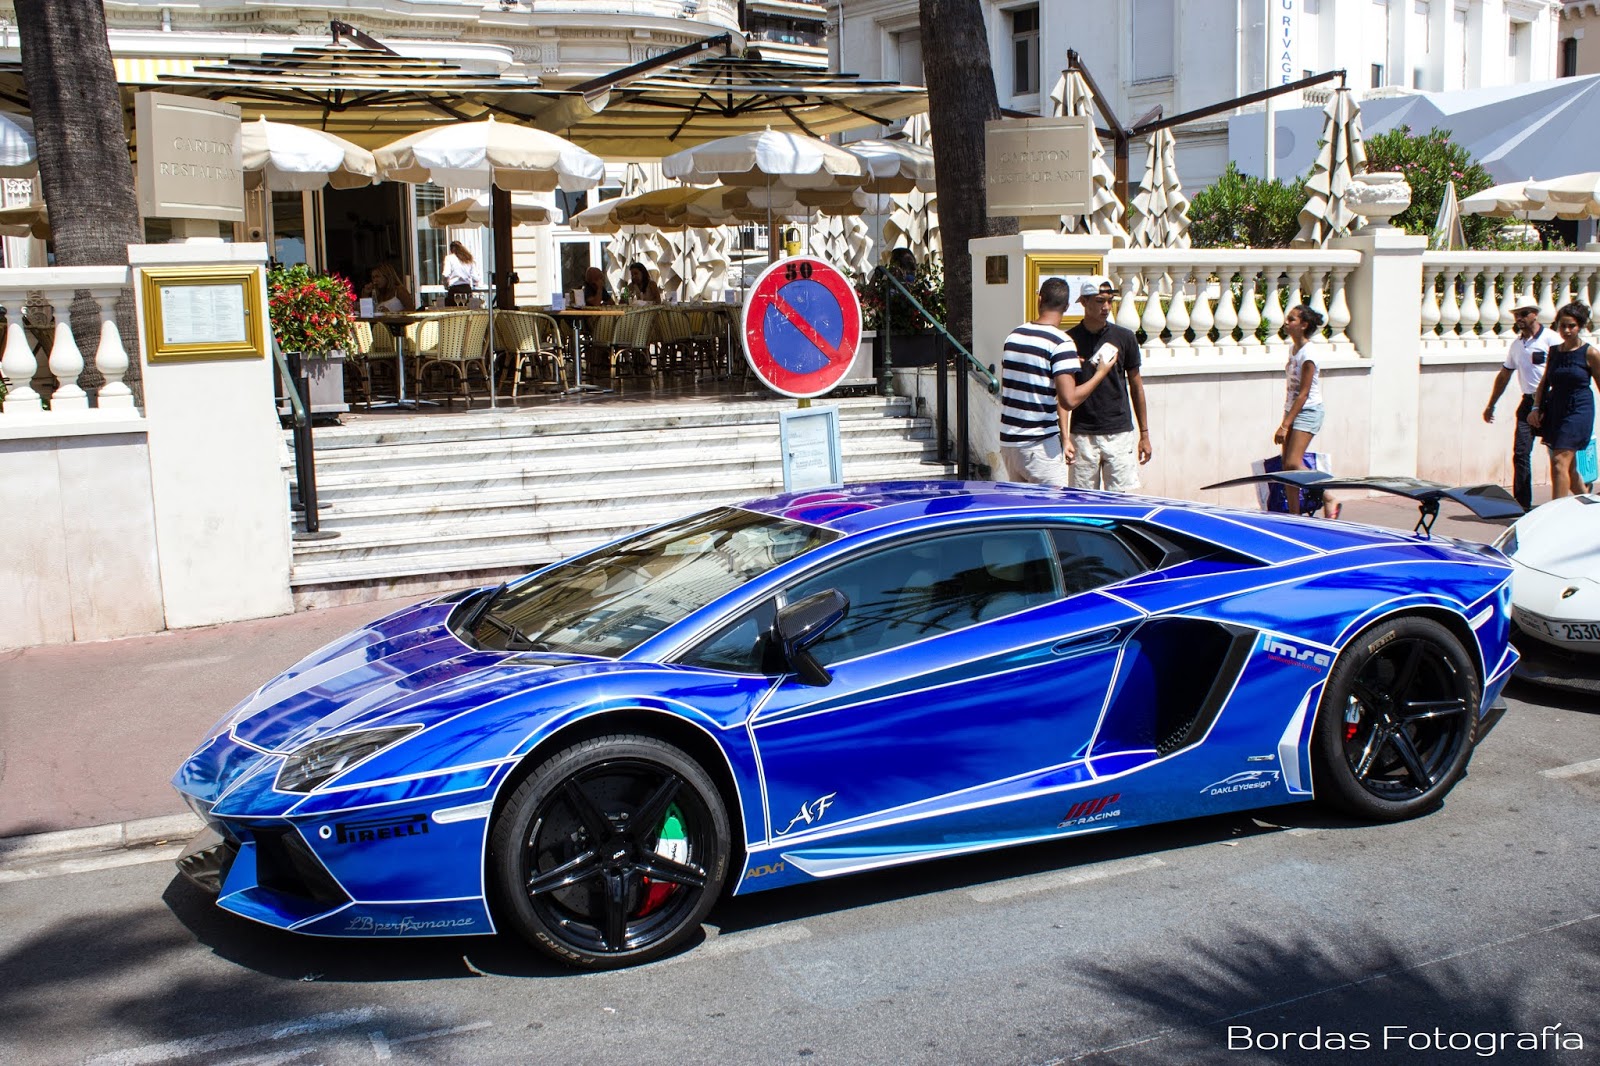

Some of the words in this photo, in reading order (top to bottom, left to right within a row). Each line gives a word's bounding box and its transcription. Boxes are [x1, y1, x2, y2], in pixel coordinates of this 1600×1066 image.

[1282, 16, 1292, 85] RIVAGE
[173, 137, 233, 155] CARLTON
[1000, 150, 1070, 163] CARLTON
[160, 162, 242, 182] RESTAURANT
[990, 170, 1085, 184] RESTAURANT
[785, 261, 812, 280] 50
[1263, 634, 1331, 667] imsa
[775, 791, 837, 835] AF
[1077, 809, 1121, 825] RACING
[335, 813, 429, 844] PIRELLI
